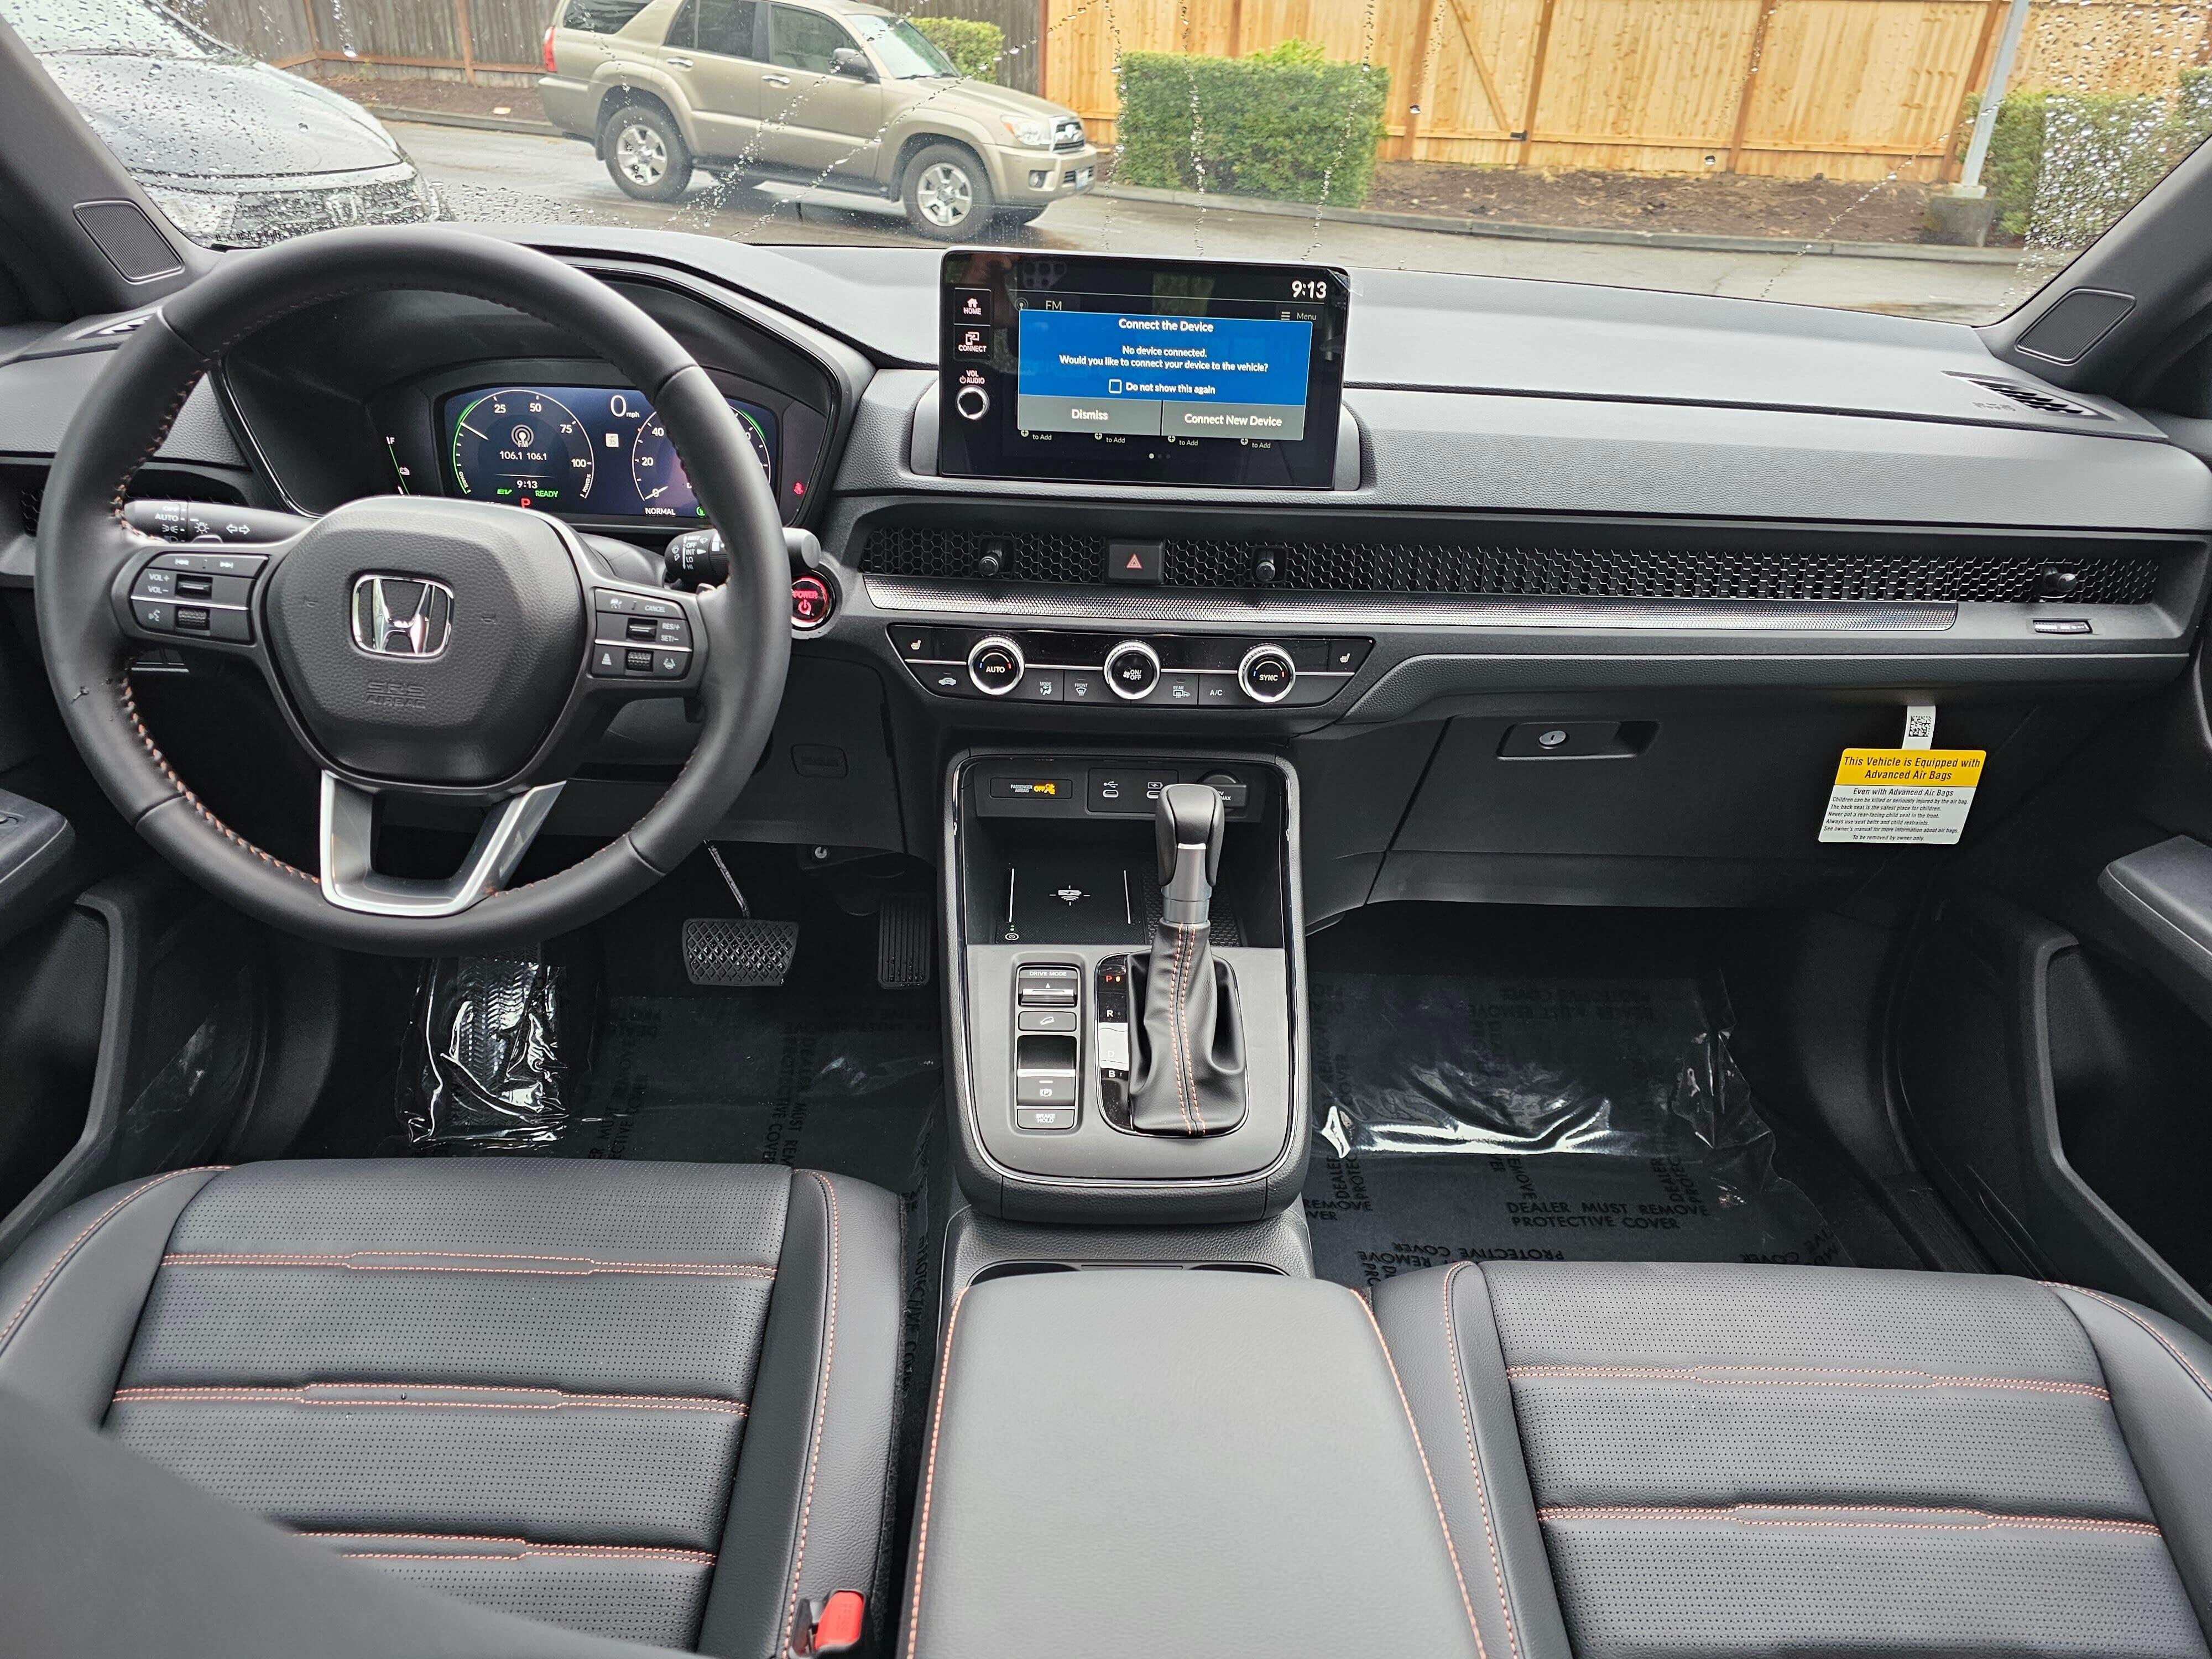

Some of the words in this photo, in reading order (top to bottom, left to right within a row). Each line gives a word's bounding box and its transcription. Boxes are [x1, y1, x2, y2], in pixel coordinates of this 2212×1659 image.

[1292, 280, 1327, 299] 9:13
[1046, 300, 1062, 310] FM
[1296, 312, 1317, 321] Menu
[1118, 318, 1160, 331] Connect
[1162, 321, 1178, 331] the
[1180, 322, 1214, 332] Device
[1122, 345, 1135, 354] No
[1136, 346, 1162, 356] device
[1163, 348, 1207, 358] connected.
[1059, 354, 1087, 365] Would
[1088, 358, 1103, 366] you
[1105, 357, 1119, 366] like
[1120, 358, 1129, 367] to
[1131, 359, 1163, 368] connect
[1164, 361, 1183, 369] your
[1184, 361, 1211, 370] device
[1212, 362, 1220, 371] to
[1222, 362, 1236, 371] the
[1237, 363, 1269, 372] vehicle?
[1125, 382, 1138, 391] Do
[1139, 383, 1154, 392] not
[1155, 383, 1176, 393] show
[1177, 384, 1193, 393] this
[1194, 385, 1215, 395] again
[494, 404, 506, 413] 25
[530, 403, 542, 413] 50
[610, 395, 627, 417] 0
[1071, 409, 1108, 420] Dismiss
[1185, 413, 1224, 425] Connect
[1226, 415, 1248, 425] New
[1250, 416, 1282, 427] Device
[560, 425, 572, 434] 75
[651, 427, 664, 437] 40
[499, 451, 523, 460] 106.1
[526, 452, 547, 461] 106.1
[571, 459, 586, 467] 100
[641, 457, 654, 466] 20
[517, 481, 538, 489] 9:13
[521, 498, 531, 508] P
[645, 507, 676, 515] NORMAL
[985, 665, 1005, 674] AUTO
[367, 681, 425, 695] SRS
[1844, 757, 1864, 766] This
[1867, 757, 1901, 766] Vehicle
[1904, 758, 1912, 766] is
[1914, 758, 1958, 769] Equipped
[1961, 759, 1980, 768] with
[1864, 770, 1911, 779] Advanced
[1913, 770, 1927, 779] Air
[1929, 771, 1952, 781] Bags
[1108, 1070, 1116, 1078] B
[1507, 1202, 1570, 1214] DEALER
[1582, 1202, 1627, 1214] MUST
[1640, 1204, 1710, 1217] REMOVE
[1512, 1216, 1615, 1228] PROTECTIVE
[1623, 1218, 1680, 1230] COVER
